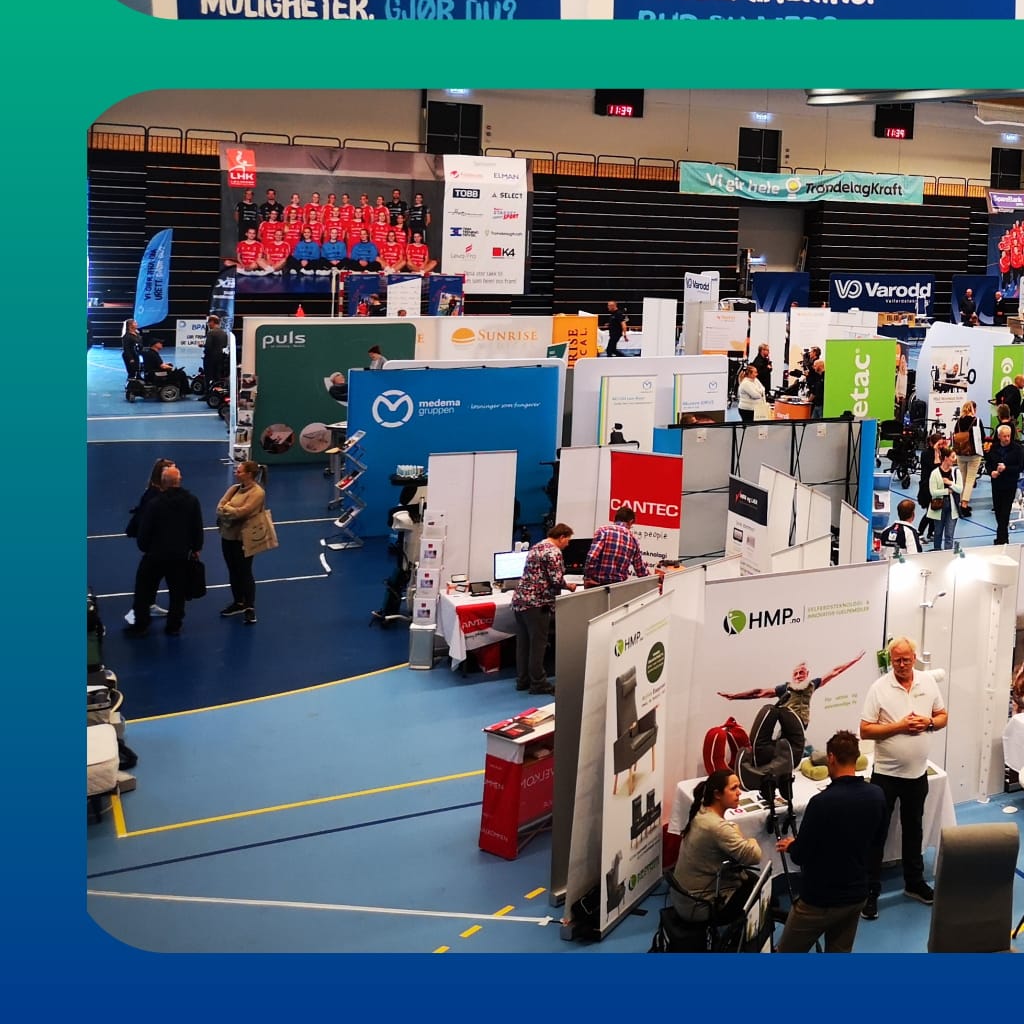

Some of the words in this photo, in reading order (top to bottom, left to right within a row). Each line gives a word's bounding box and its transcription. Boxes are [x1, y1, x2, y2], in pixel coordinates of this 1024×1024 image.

[607, 105, 633, 116] 11:39
[886, 128, 905, 138] 11:39
[230, 172, 254, 181] LHK
[706, 172, 722, 187] Vi
[725, 178, 744, 192] gir
[748, 180, 780, 195] hele
[454, 189, 479, 198] TOBB
[502, 248, 515, 257] K4
[692, 279, 710, 291] Varodd
[864, 281, 931, 298] Varodd
[262, 330, 306, 349] puls
[478, 329, 539, 343] SUNRISE
[852, 353, 871, 417] etac
[418, 399, 461, 408] medema
[418, 406, 455, 417] gruppen
[610, 498, 679, 517] CANTEC
